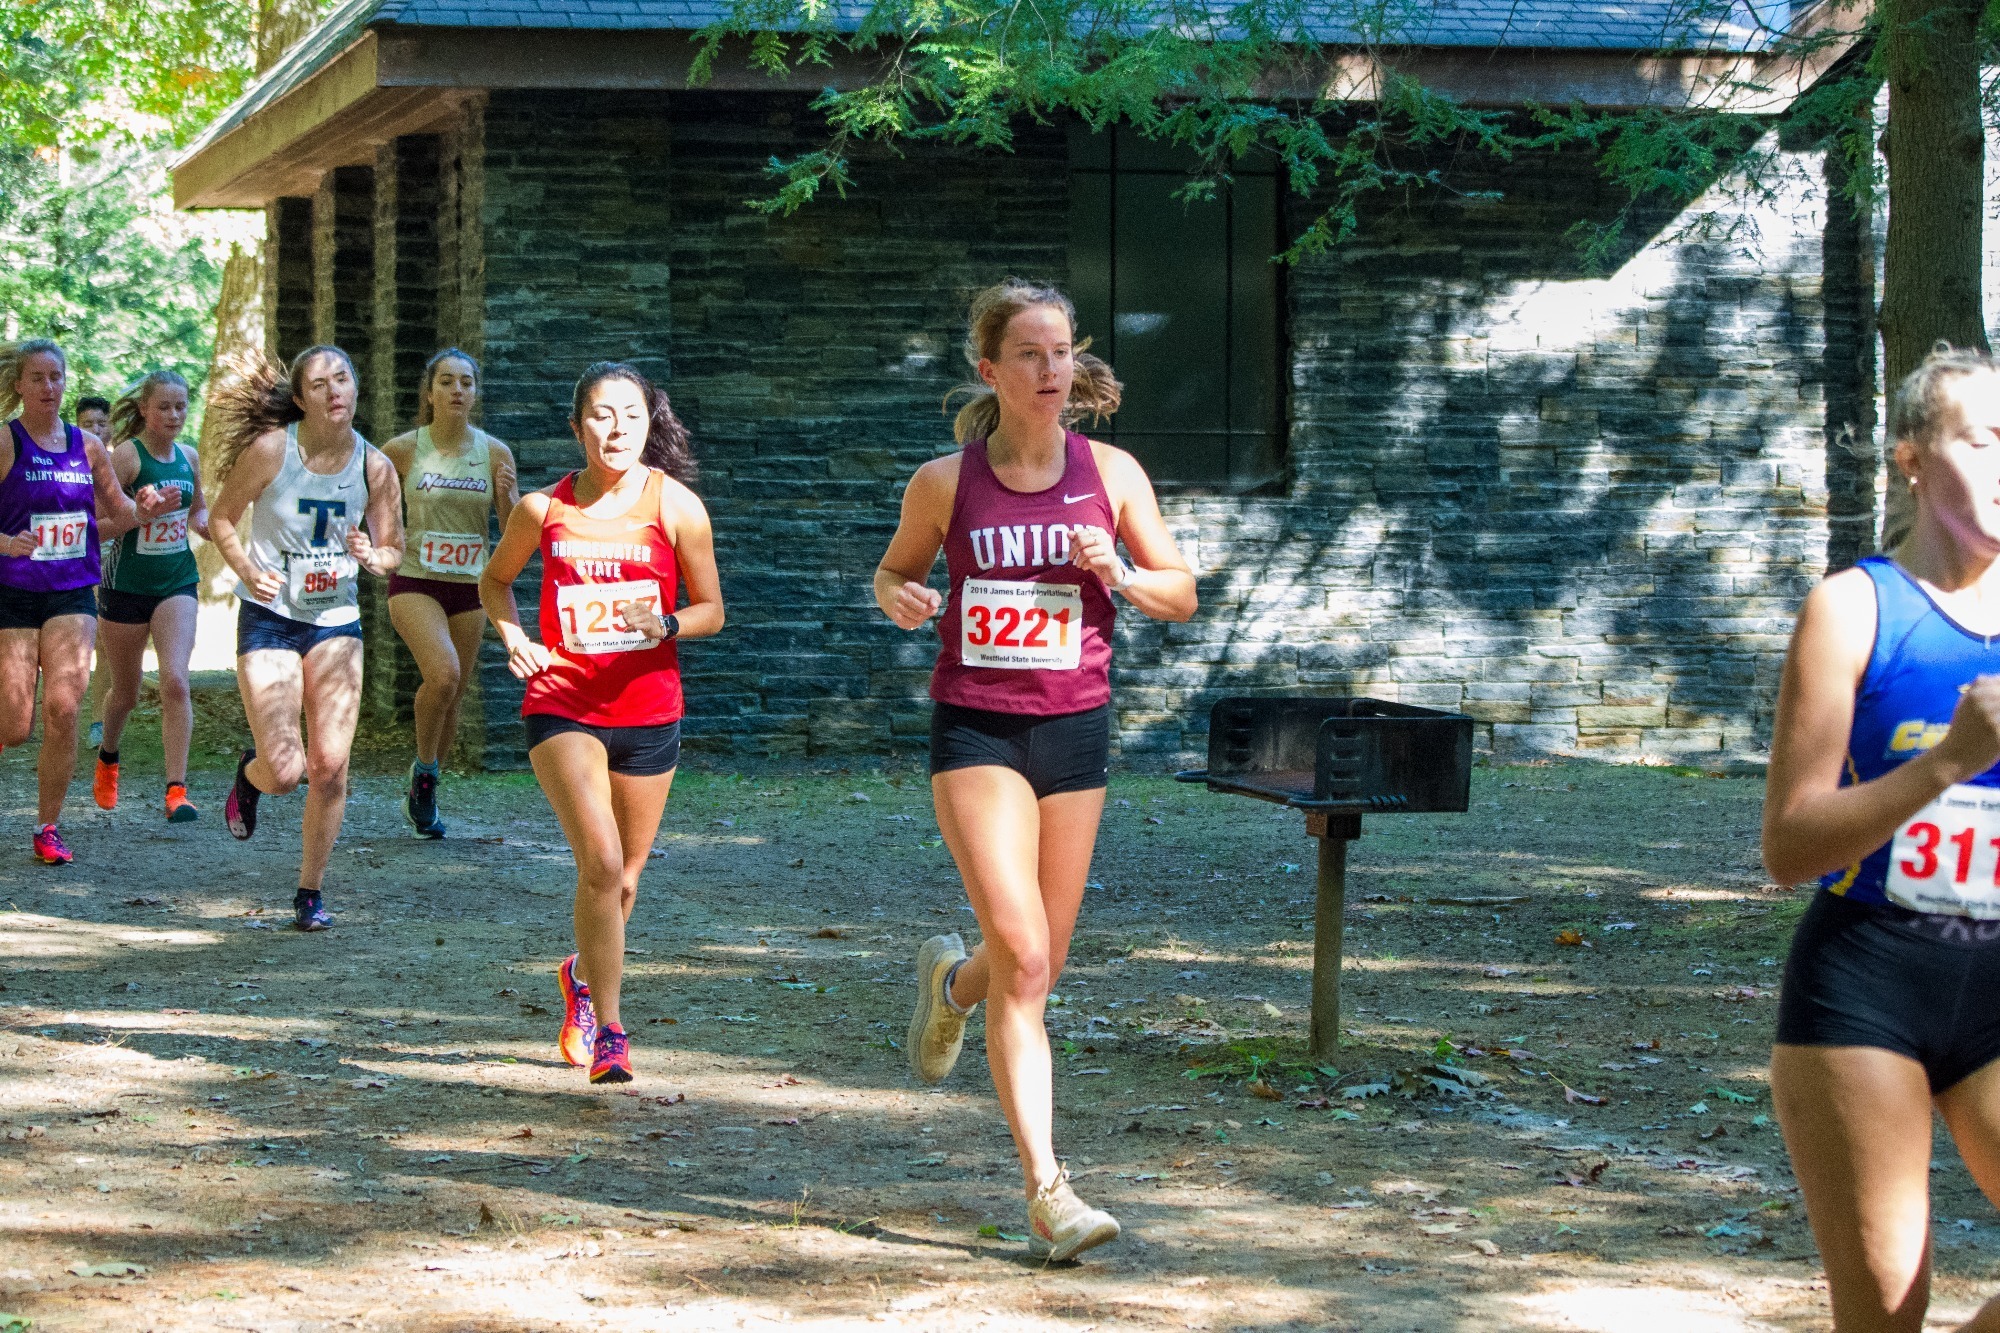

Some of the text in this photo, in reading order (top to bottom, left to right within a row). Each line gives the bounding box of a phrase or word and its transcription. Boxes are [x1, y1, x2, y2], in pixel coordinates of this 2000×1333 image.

[25, 470, 94, 485] SAINT MICHAEL'S
[153, 479, 194, 496] YMOUTH
[416, 472, 488, 494] Norwich
[141, 518, 187, 544] 1235
[298, 498, 347, 548] T
[35, 522, 86, 548] 1167
[424, 540, 483, 566] 1207
[313, 560, 332, 568] ECAC
[575, 559, 622, 579] STATE
[304, 570, 338, 594] 954
[970, 586, 1073, 598] 2019 James Early Invitational
[967, 605, 1071, 648] 3221
[620, 637, 652, 646] University
[980, 654, 1011, 663] Westfield
[1012, 655, 1030, 663] State
